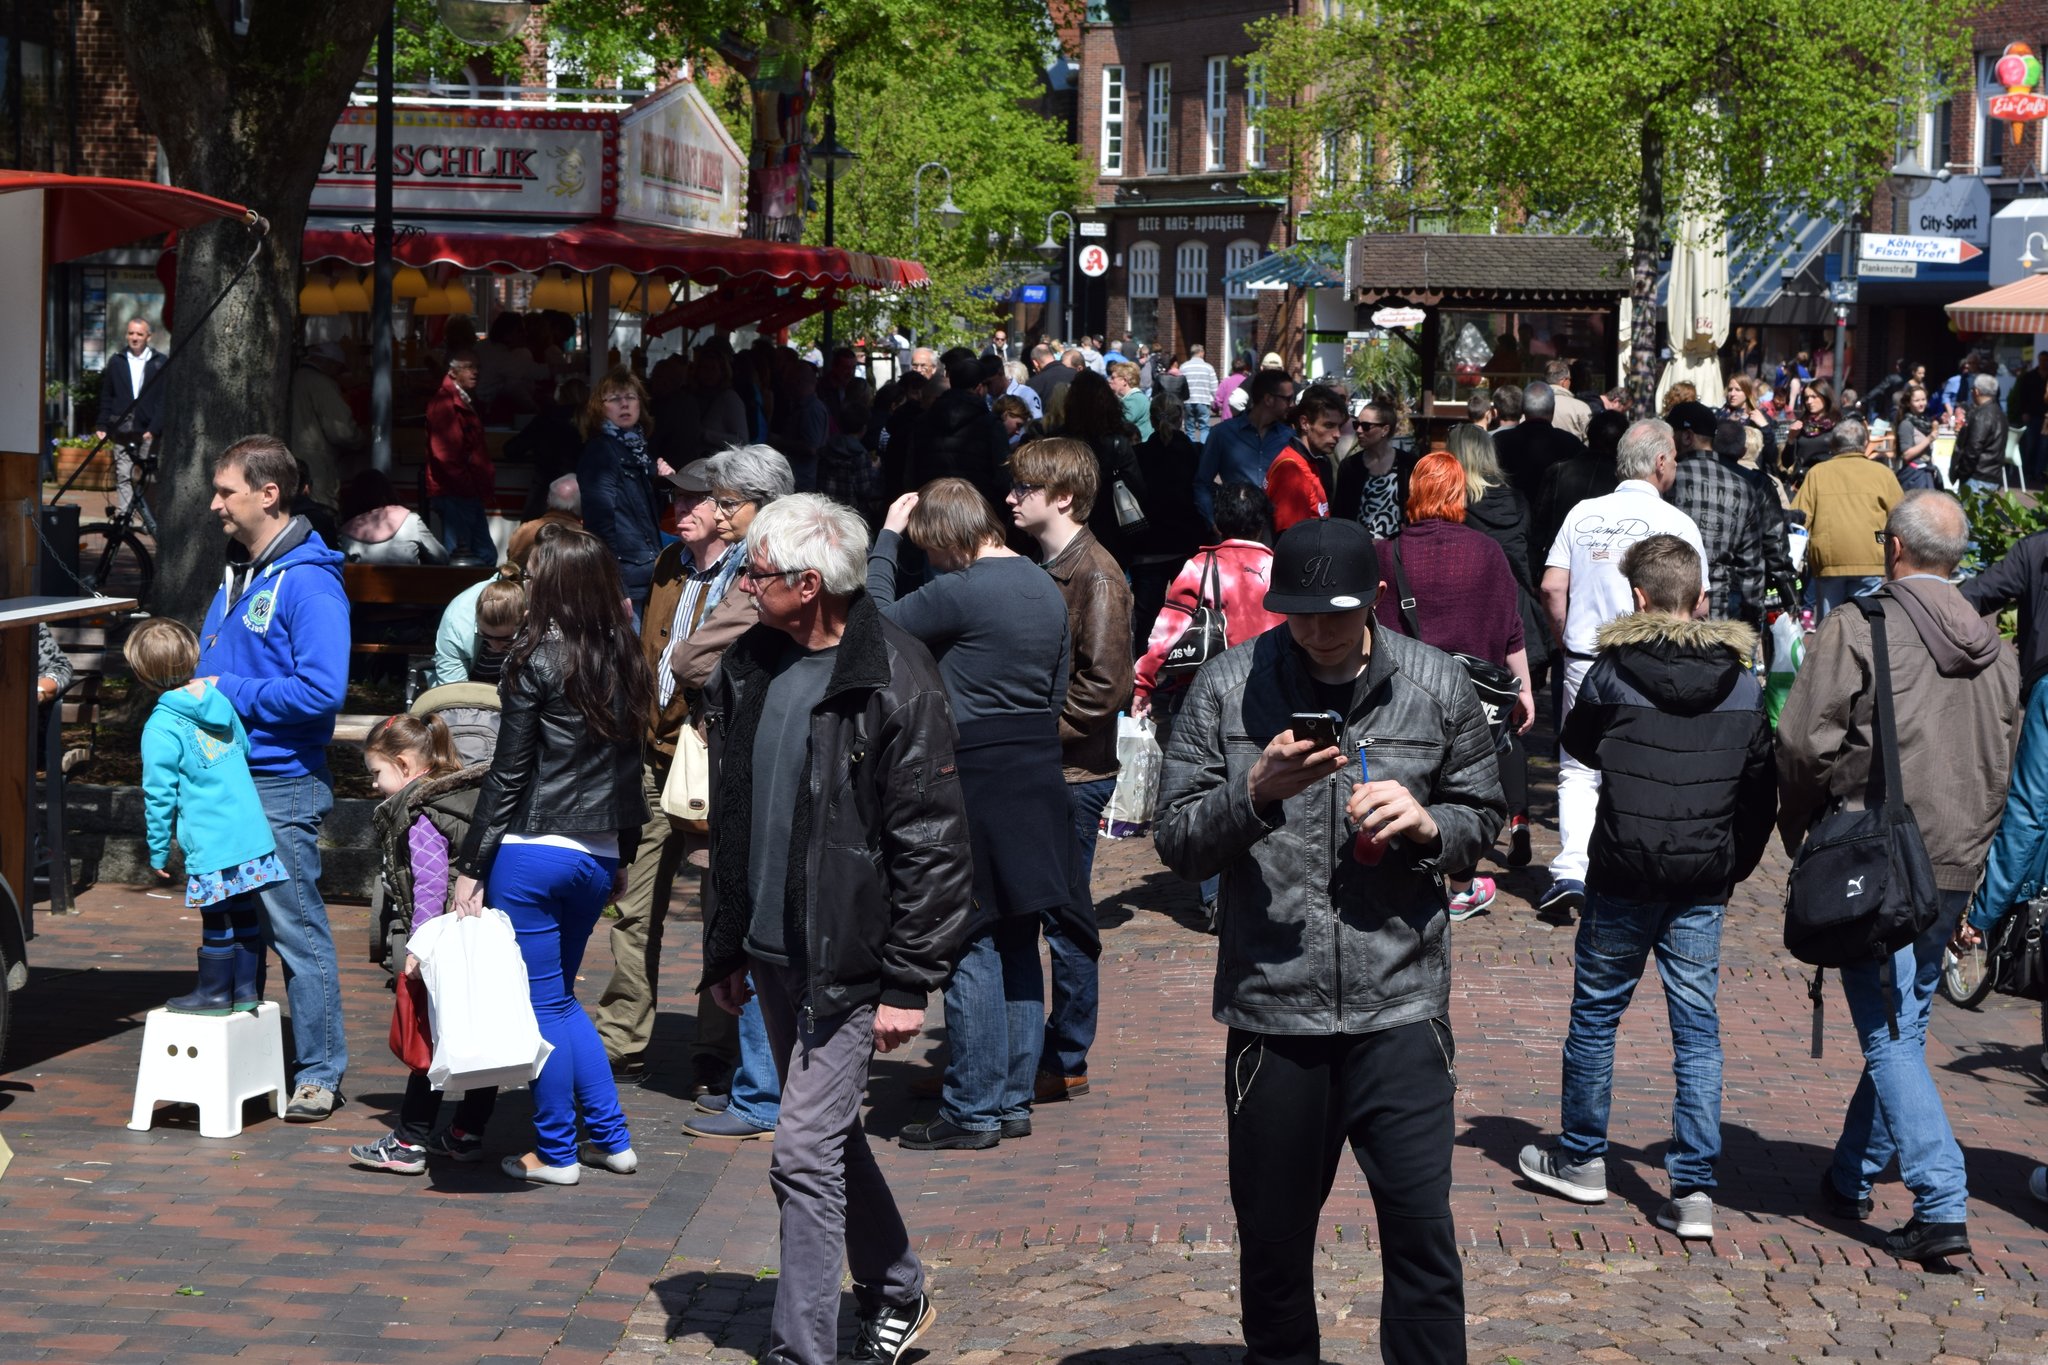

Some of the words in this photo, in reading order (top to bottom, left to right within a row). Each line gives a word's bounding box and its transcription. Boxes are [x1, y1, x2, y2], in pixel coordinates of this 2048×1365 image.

[1920, 214, 1977, 232] City-Sport
[1887, 238, 1939, 250] Köhler's
[1874, 247, 1908, 256] Fisch
[1917, 249, 1947, 259] Treff
[1861, 263, 1914, 274] Plankenstraße
